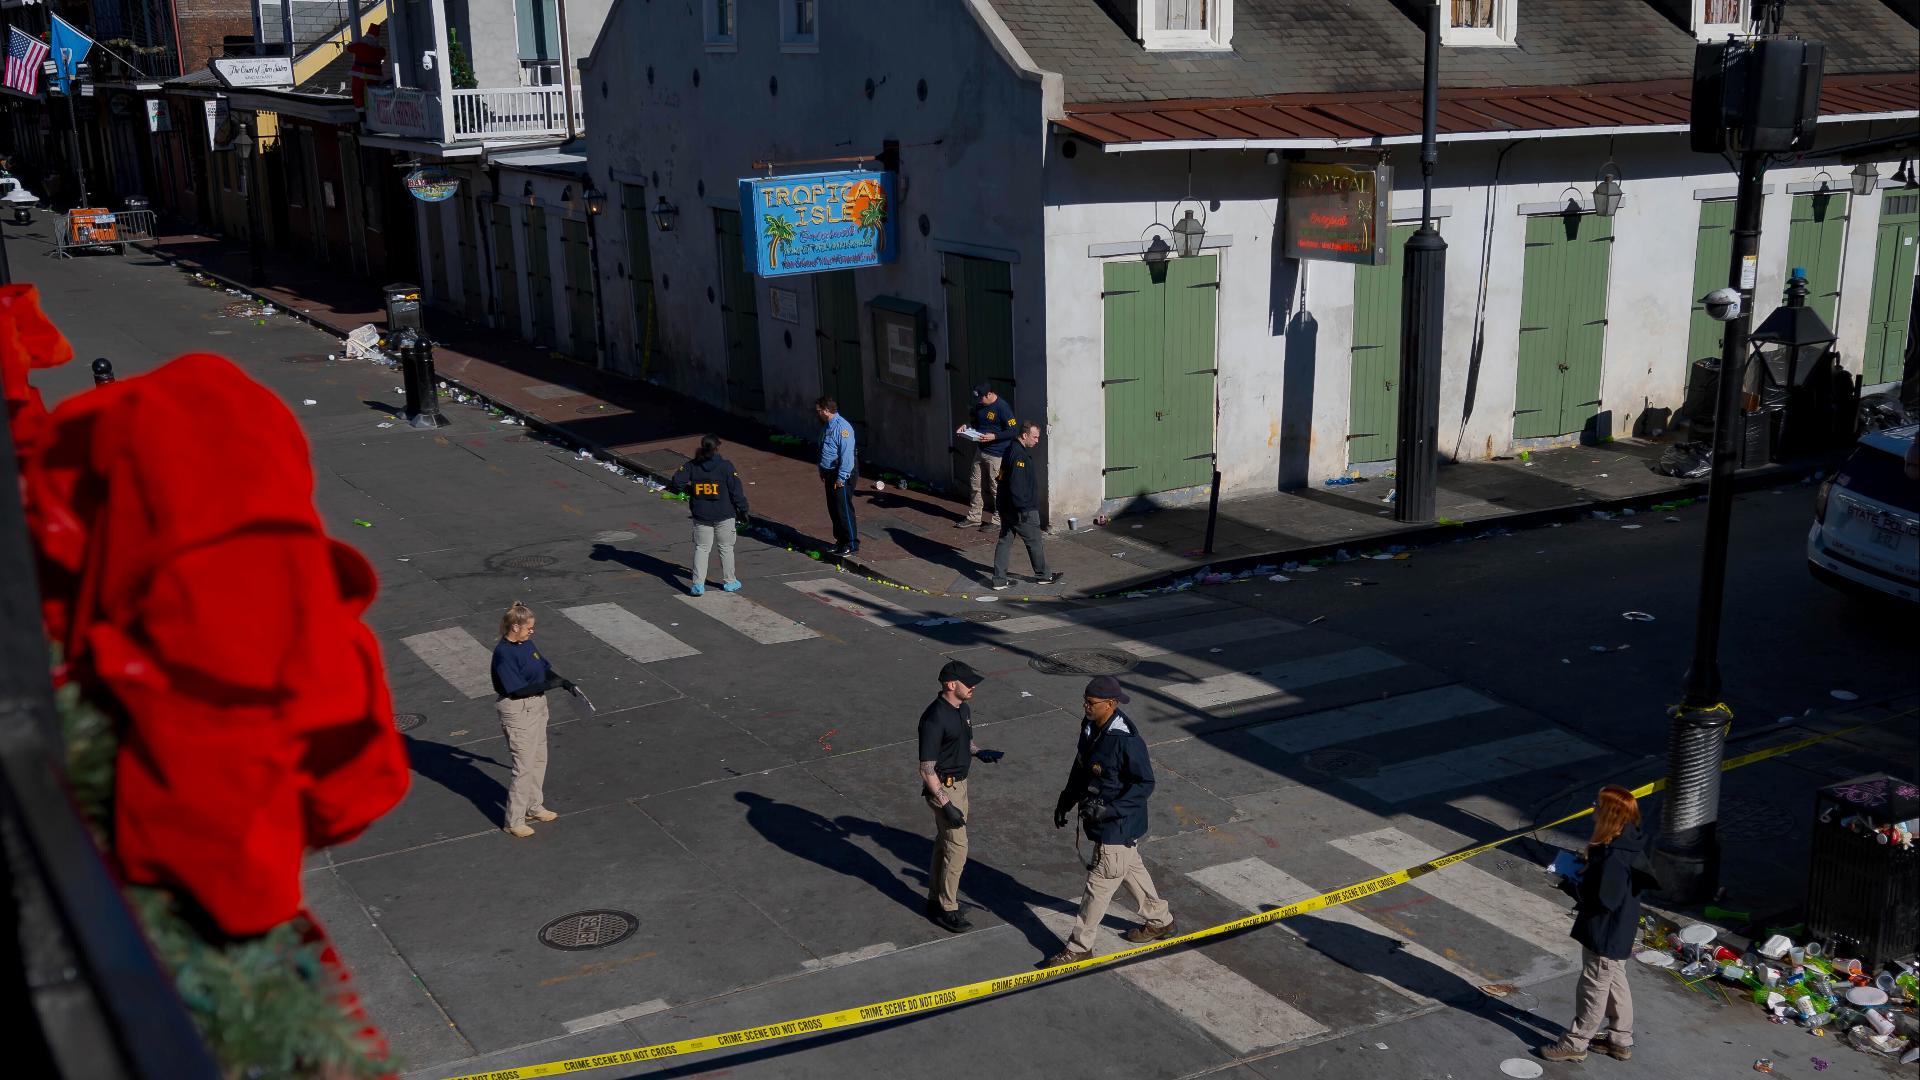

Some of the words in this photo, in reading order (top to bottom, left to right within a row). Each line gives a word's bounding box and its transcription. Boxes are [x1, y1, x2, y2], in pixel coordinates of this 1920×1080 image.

[761, 179, 884, 209] TROPICAL
[794, 202, 856, 228] ISLE
[695, 483, 719, 496] FBI
[1848, 505, 1879, 526] STATE
[1325, 894, 1342, 906] CRIME
[1342, 888, 1359, 903] SCENE
[1360, 885, 1367, 895] DO
[1367, 881, 1378, 892] NOT
[1378, 876, 1396, 890] CROSS
[991, 979, 1013, 993] CRIME
[1013, 974, 1035, 988] SCENE
[860, 1006, 883, 1020] CRIME
[884, 1001, 908, 1015] SCENE
[908, 999, 919, 1011] DO
[919, 996, 933, 1008] NOT
[934, 991, 957, 1005] CROSS
[718, 1033, 743, 1046] CRIME
[744, 1029, 769, 1043] SCENE
[770, 1026, 781, 1037] DO
[781, 1023, 797, 1035] NOT
[798, 1018, 823, 1032] CROSS
[564, 1059, 591, 1072] CRIME
[592, 1053, 619, 1067] SCENE
[620, 1052, 632, 1063] DO
[633, 1049, 649, 1061] NOT
[651, 1045, 678, 1058] CROSS
